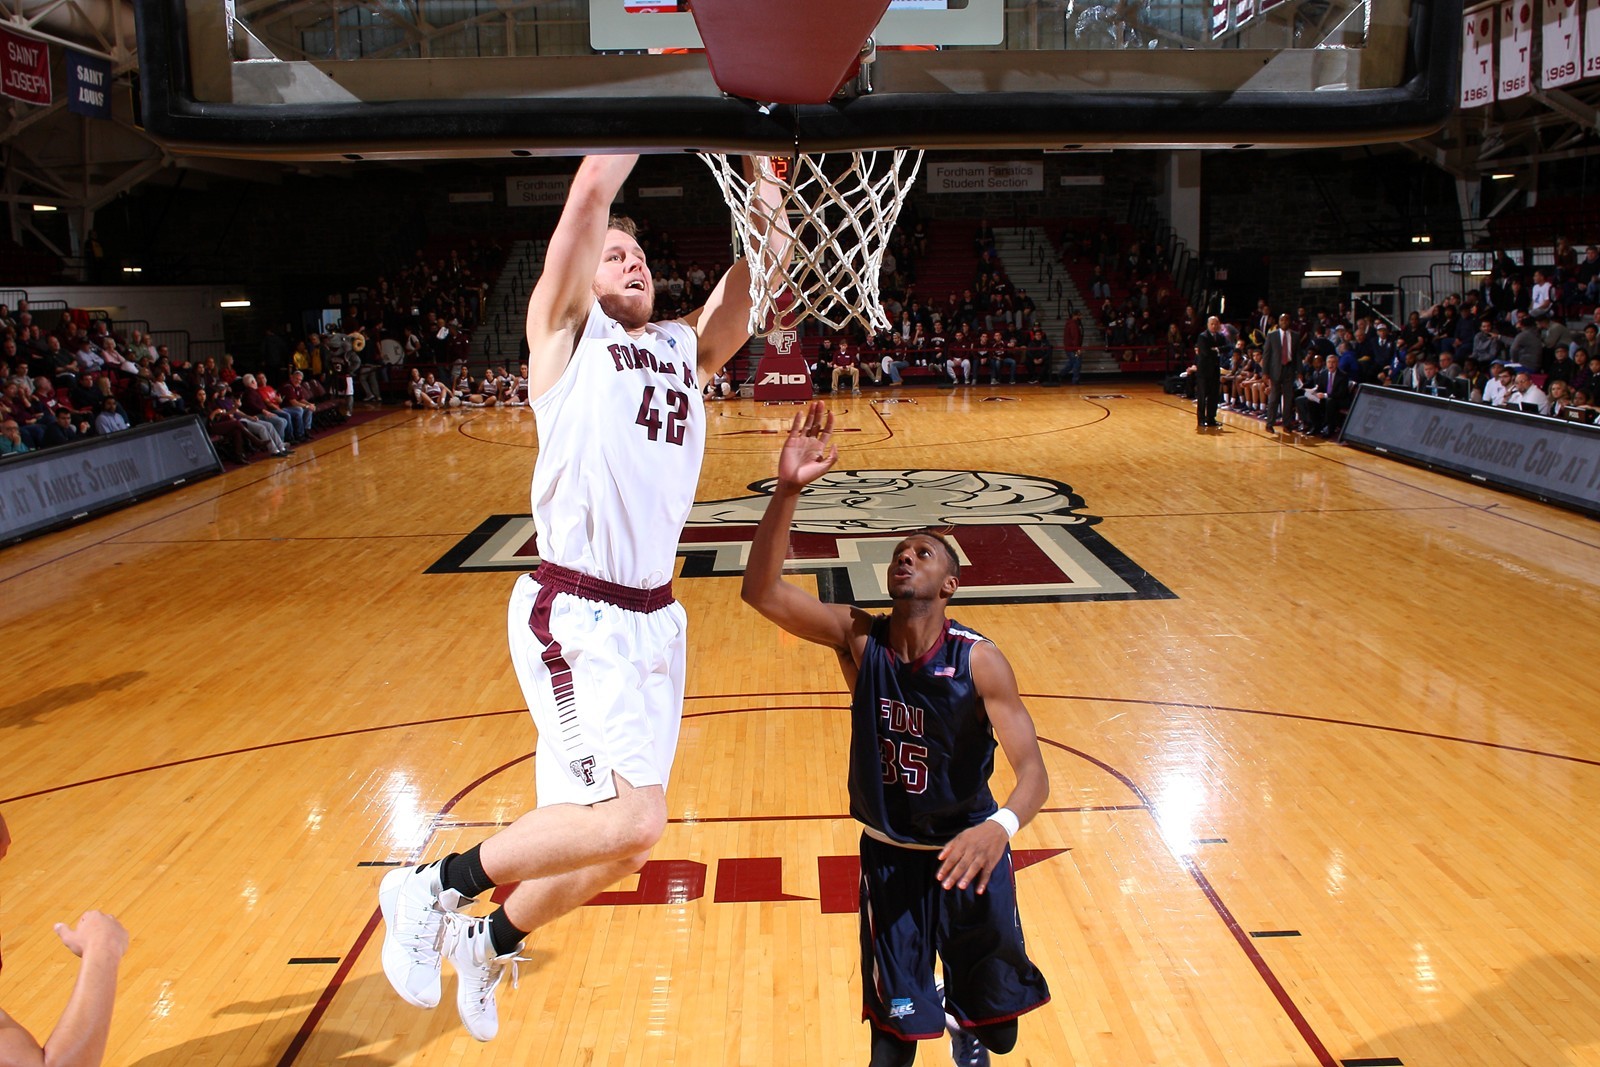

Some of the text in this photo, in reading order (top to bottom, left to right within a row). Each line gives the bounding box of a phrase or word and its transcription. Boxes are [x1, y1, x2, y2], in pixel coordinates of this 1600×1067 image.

[7, 42, 39, 67] SAINT
[5, 68, 47, 94] JOSEPH
[76, 65, 104, 86] SAINT
[1546, 62, 1575, 81] 1969
[78, 87, 104, 107] LOUIS
[936, 166, 1033, 177] Fordham Fanatics
[516, 180, 564, 191] Fordham
[942, 177, 1028, 188] Student Section
[522, 192, 564, 202] Student
[758, 372, 806, 386] A10
[635, 385, 689, 446] 42
[1523, 438, 1562, 477] CUP
[1558, 456, 1588, 484] AT
[11, 487, 32, 516] AT
[879, 697, 925, 738] FDU
[877, 735, 929, 795] 35
[890, 1002, 914, 1015] NEC
